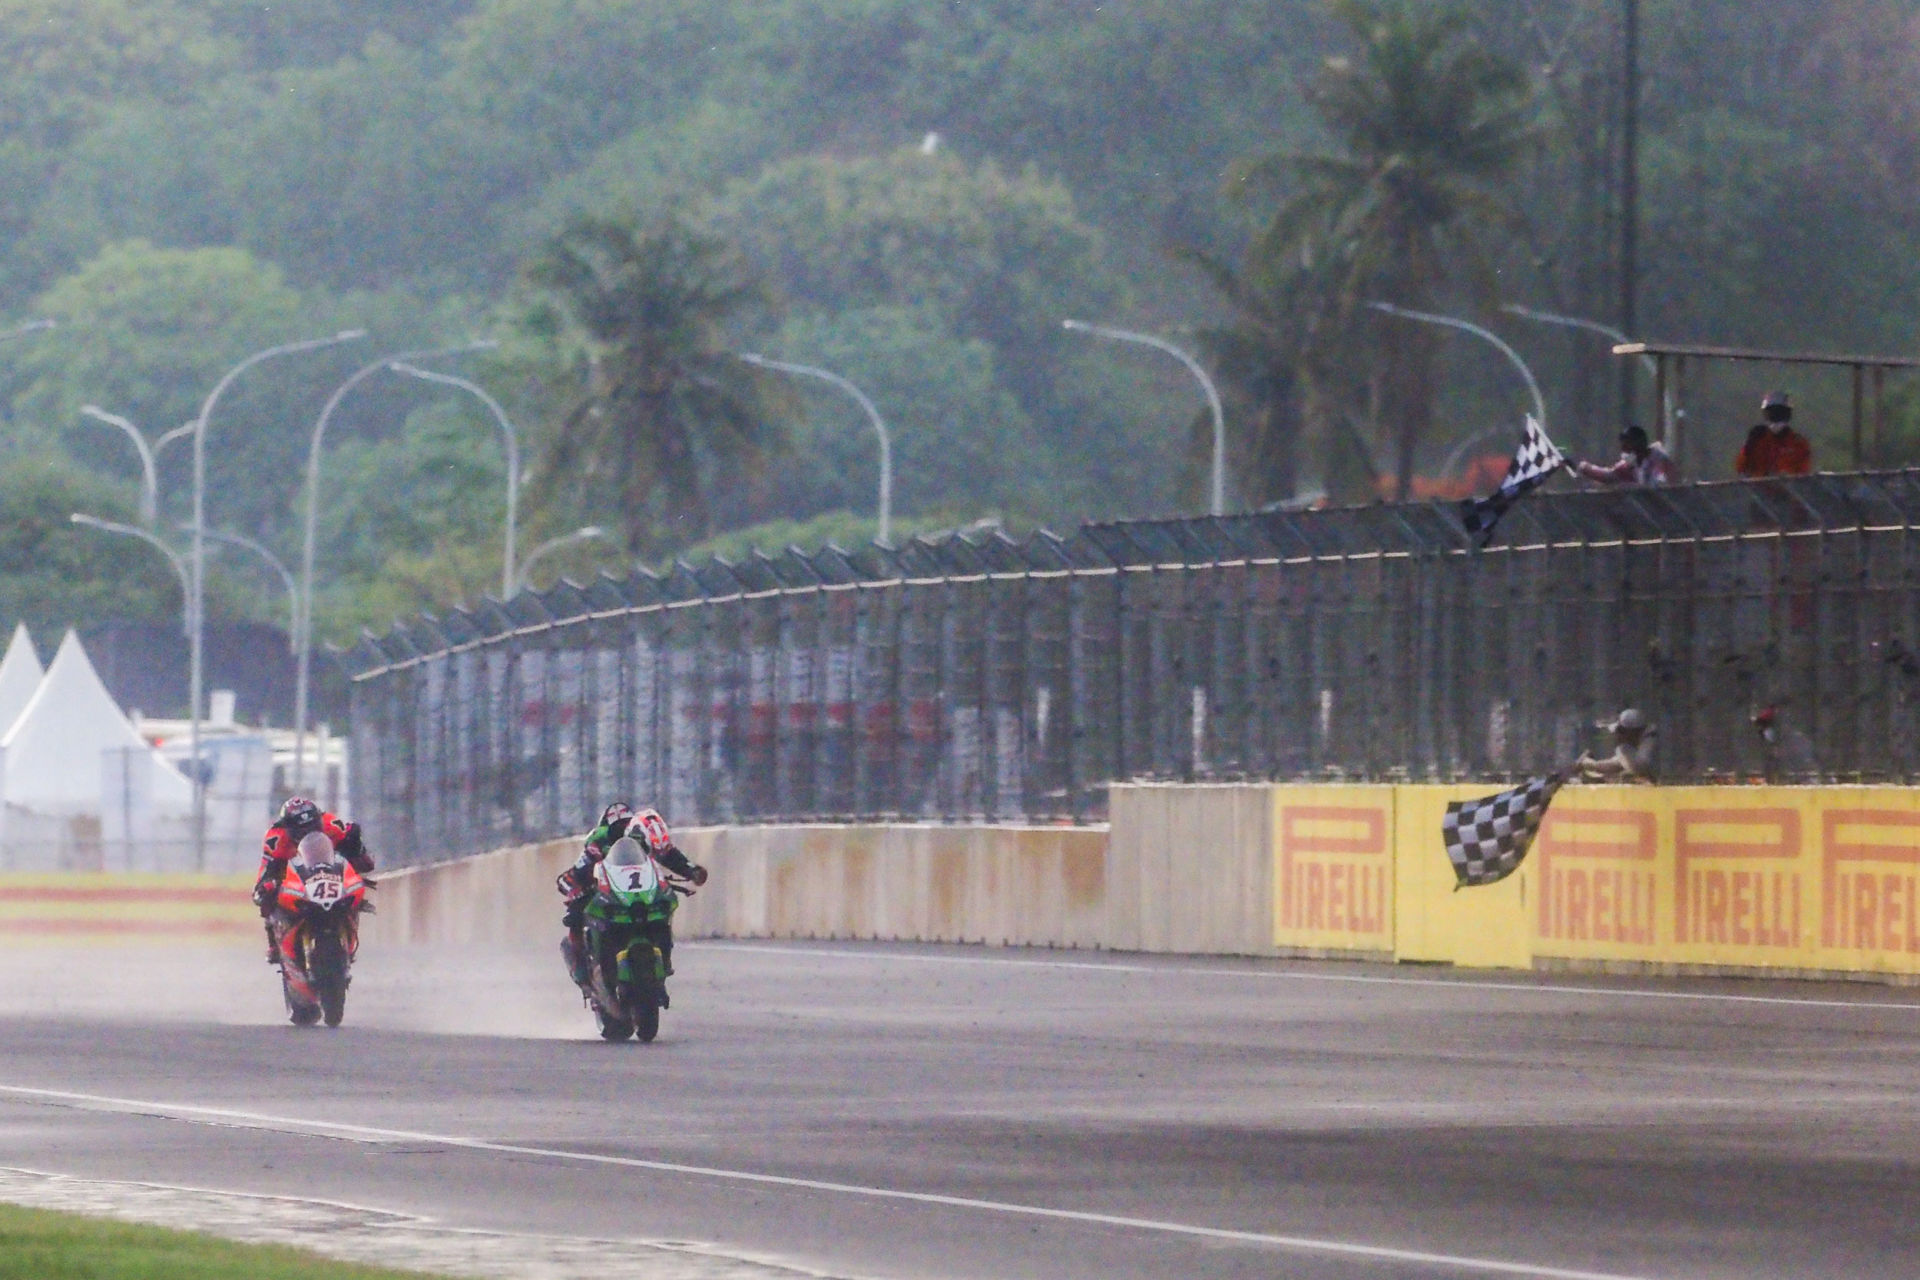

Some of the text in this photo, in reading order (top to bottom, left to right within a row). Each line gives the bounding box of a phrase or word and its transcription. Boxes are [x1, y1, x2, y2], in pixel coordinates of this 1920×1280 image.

[313, 882, 339, 899] 45
[628, 872, 642, 890] 1
[1281, 806, 1385, 934] PIRELLI
[1538, 808, 1656, 945] PIRELLI
[1675, 808, 1801, 948] PIRELLI
